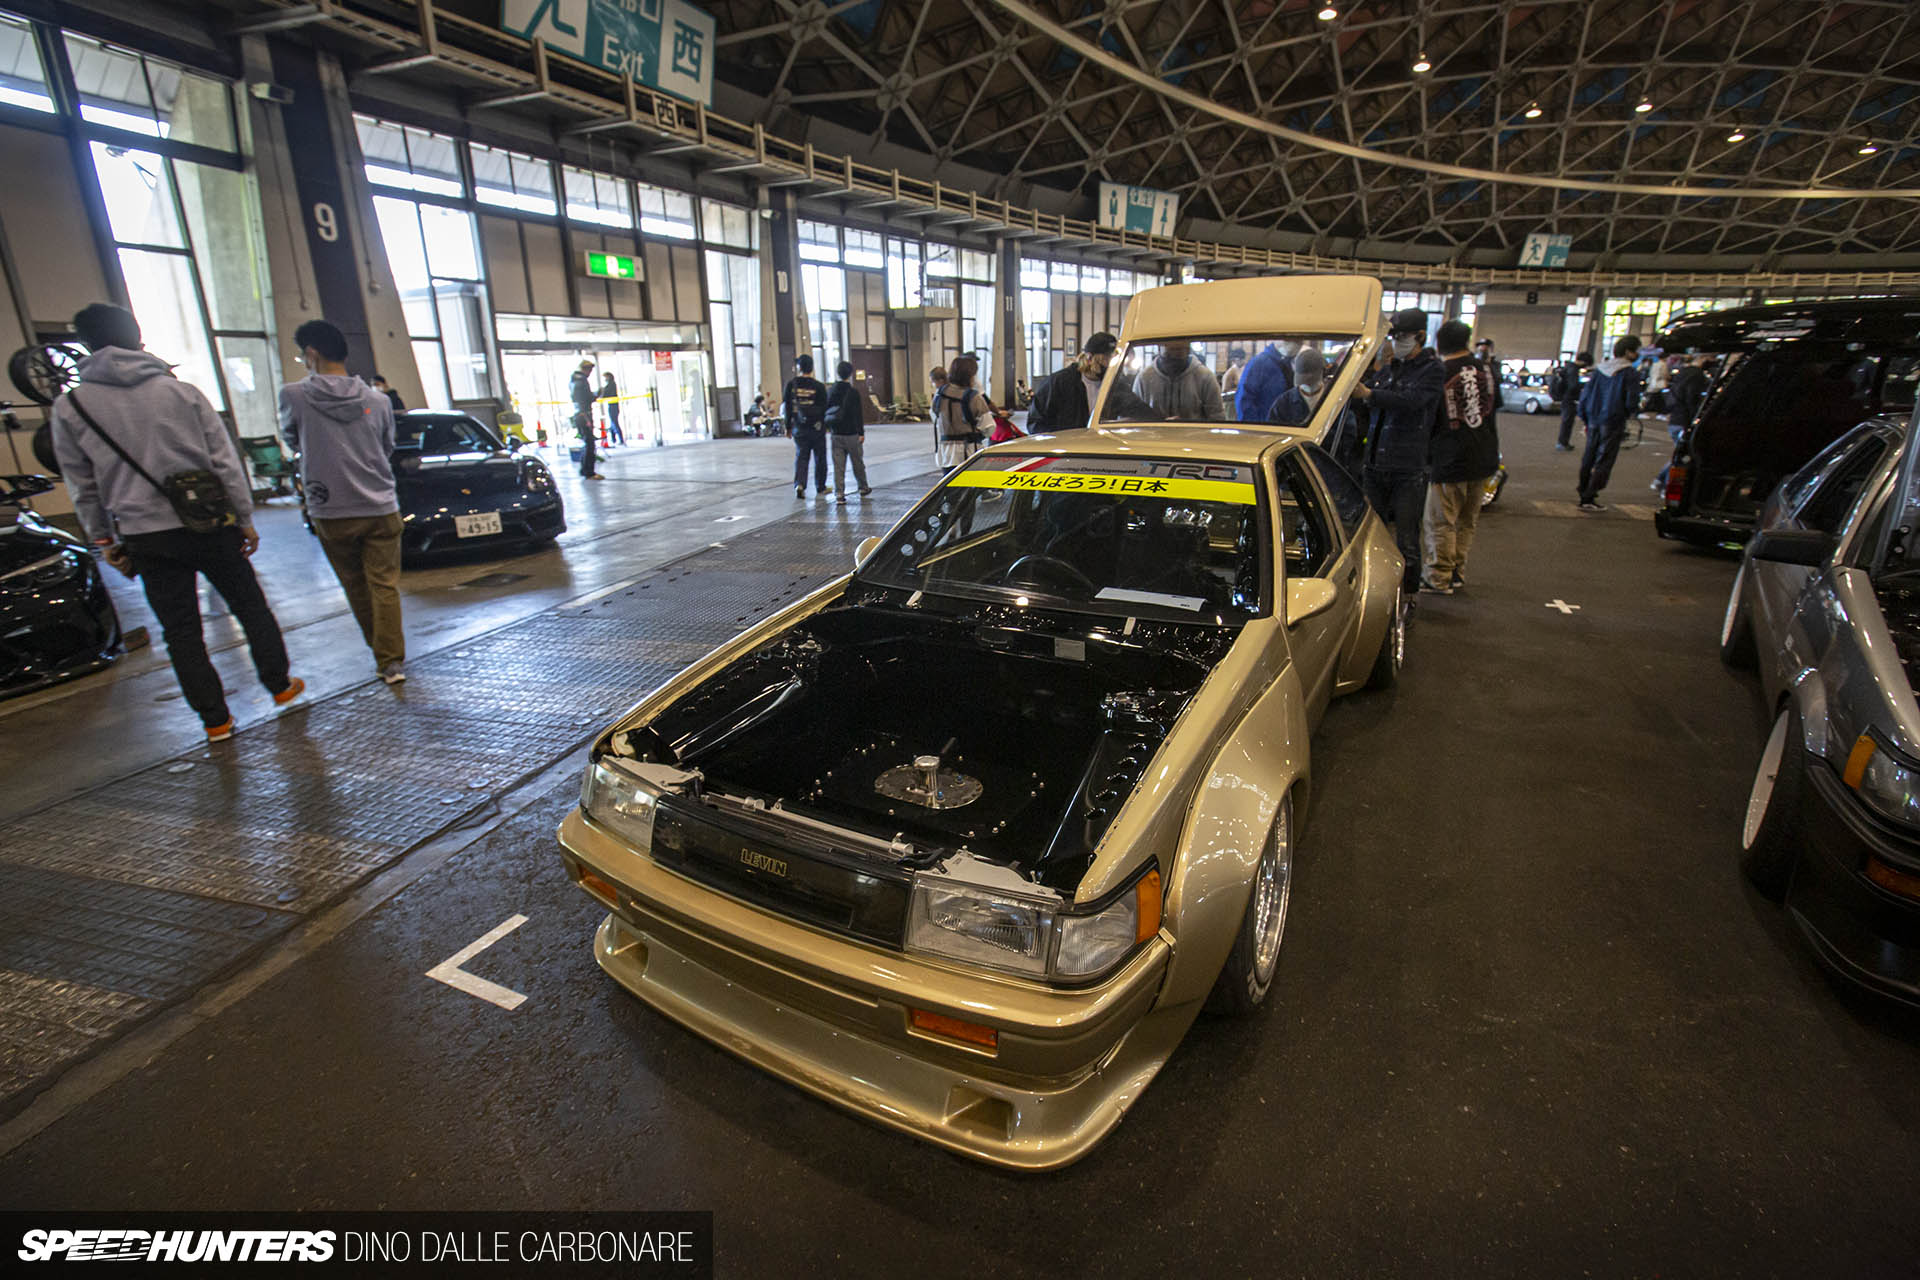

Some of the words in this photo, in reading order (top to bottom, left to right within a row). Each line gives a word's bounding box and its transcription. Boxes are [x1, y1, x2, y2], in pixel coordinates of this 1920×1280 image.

[602, 33, 645, 80] Exit
[672, 18, 704, 83] 西
[313, 202, 339, 242] 9
[777, 270, 789, 293] 10
[1005, 295, 1014, 311] 11
[1001, 474, 1169, 493] がんばろう!日本
[1143, 461, 1239, 480] TRD
[740, 847, 788, 877] LEVIN
